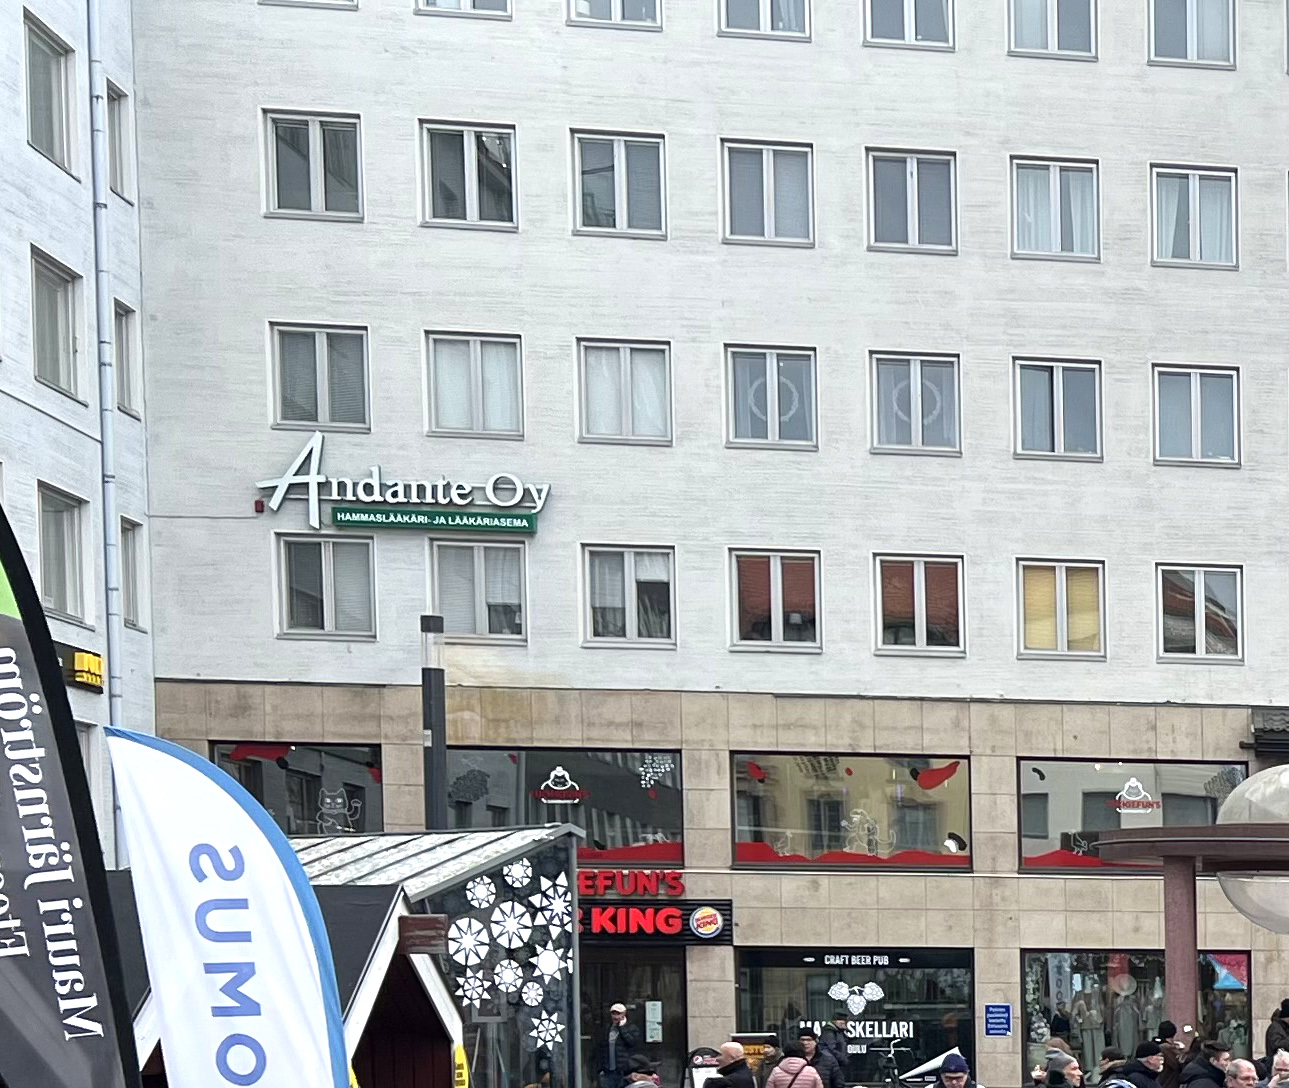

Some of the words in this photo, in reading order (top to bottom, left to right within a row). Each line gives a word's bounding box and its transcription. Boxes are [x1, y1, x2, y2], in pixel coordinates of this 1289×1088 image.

[254, 430, 474, 530] Andante
[484, 472, 551, 514] Oy
[432, 515, 447, 526] JA
[448, 514, 529, 528] LÄÄKÄRIASEMA
[577, 870, 686, 897] EFUN'S
[591, 907, 683, 935] KING
[824, 954, 850, 965] CRAFT
[851, 954, 872, 965] BEER
[872, 954, 889, 966] PUB
